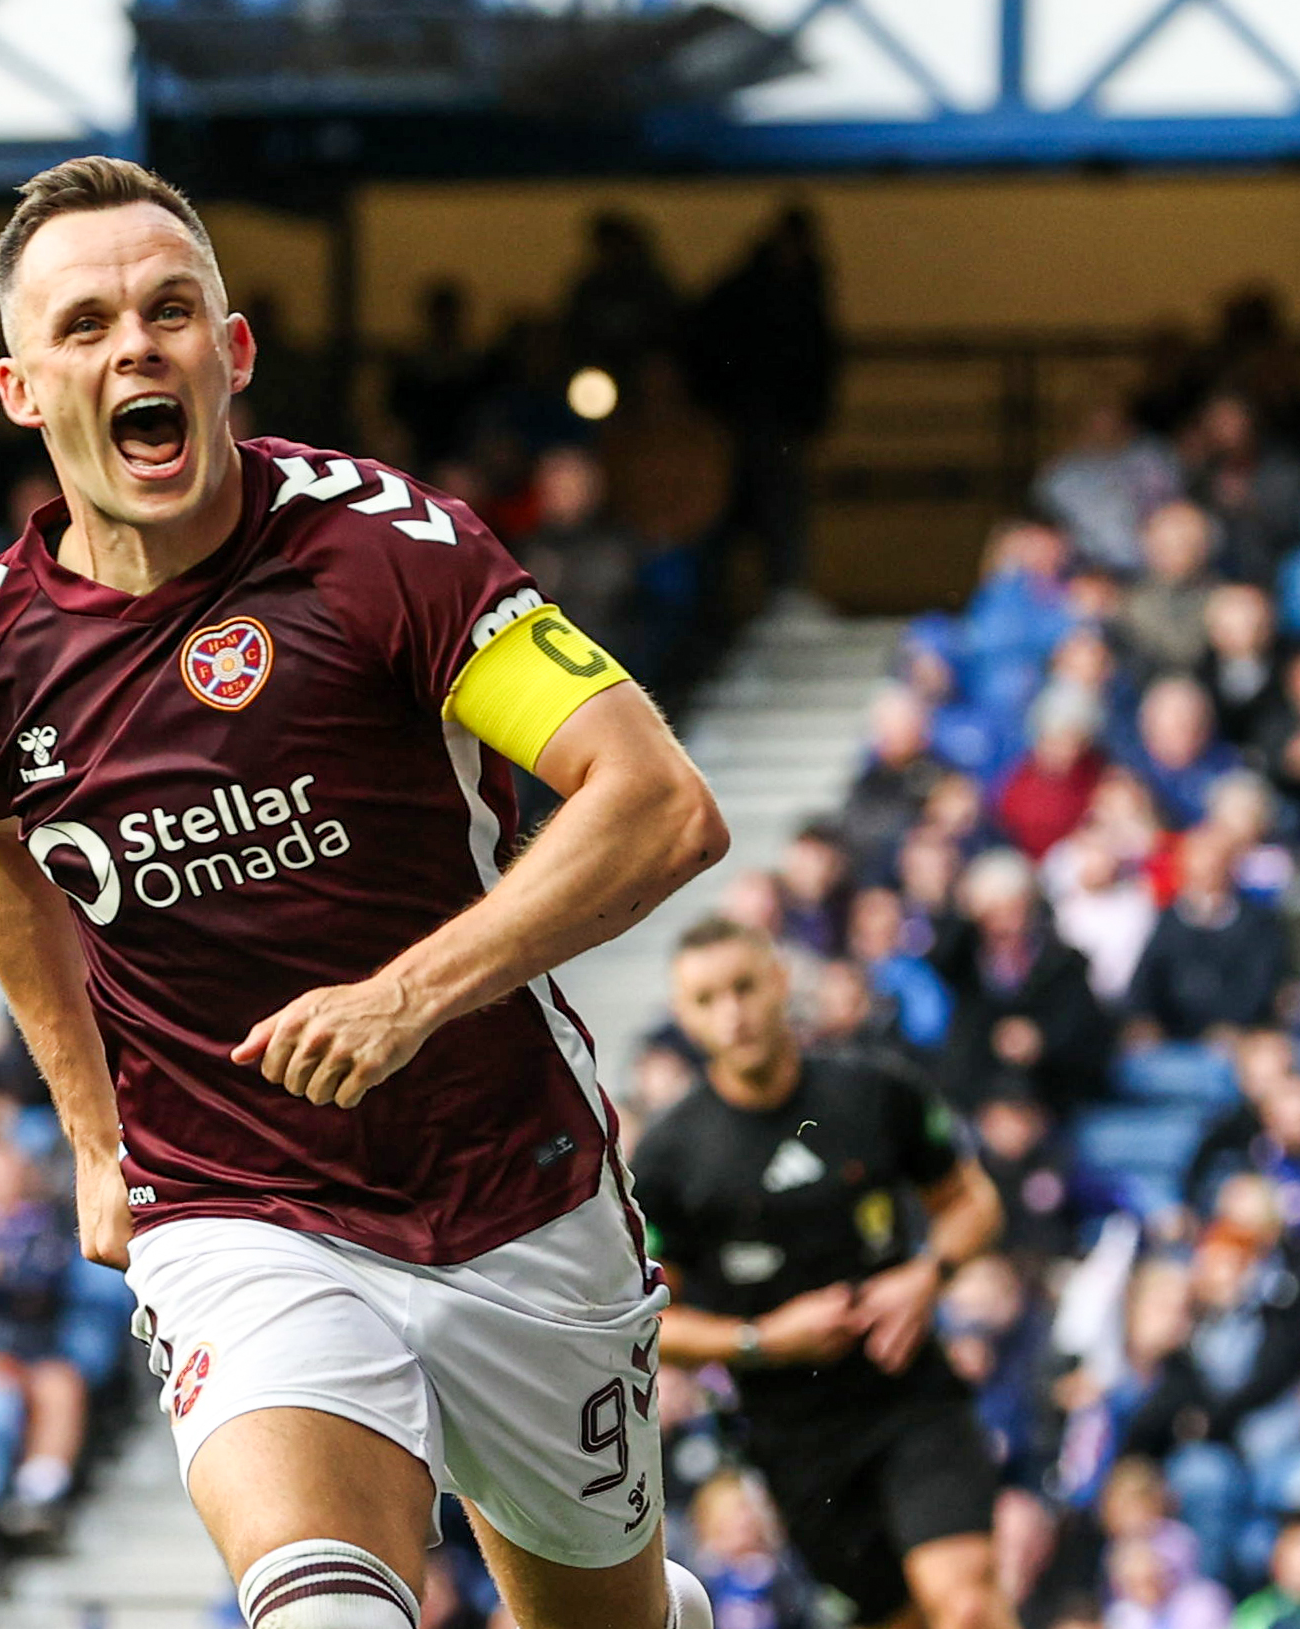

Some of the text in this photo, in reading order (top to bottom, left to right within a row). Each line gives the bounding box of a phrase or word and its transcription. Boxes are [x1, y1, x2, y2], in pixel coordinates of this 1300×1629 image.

[199, 665, 209, 678] F
[245, 648, 258, 660] C
[532, 617, 607, 678] C
[119, 774, 315, 862] Stellar
[134, 819, 351, 908] Omada
[580, 1376, 629, 1499] 9
